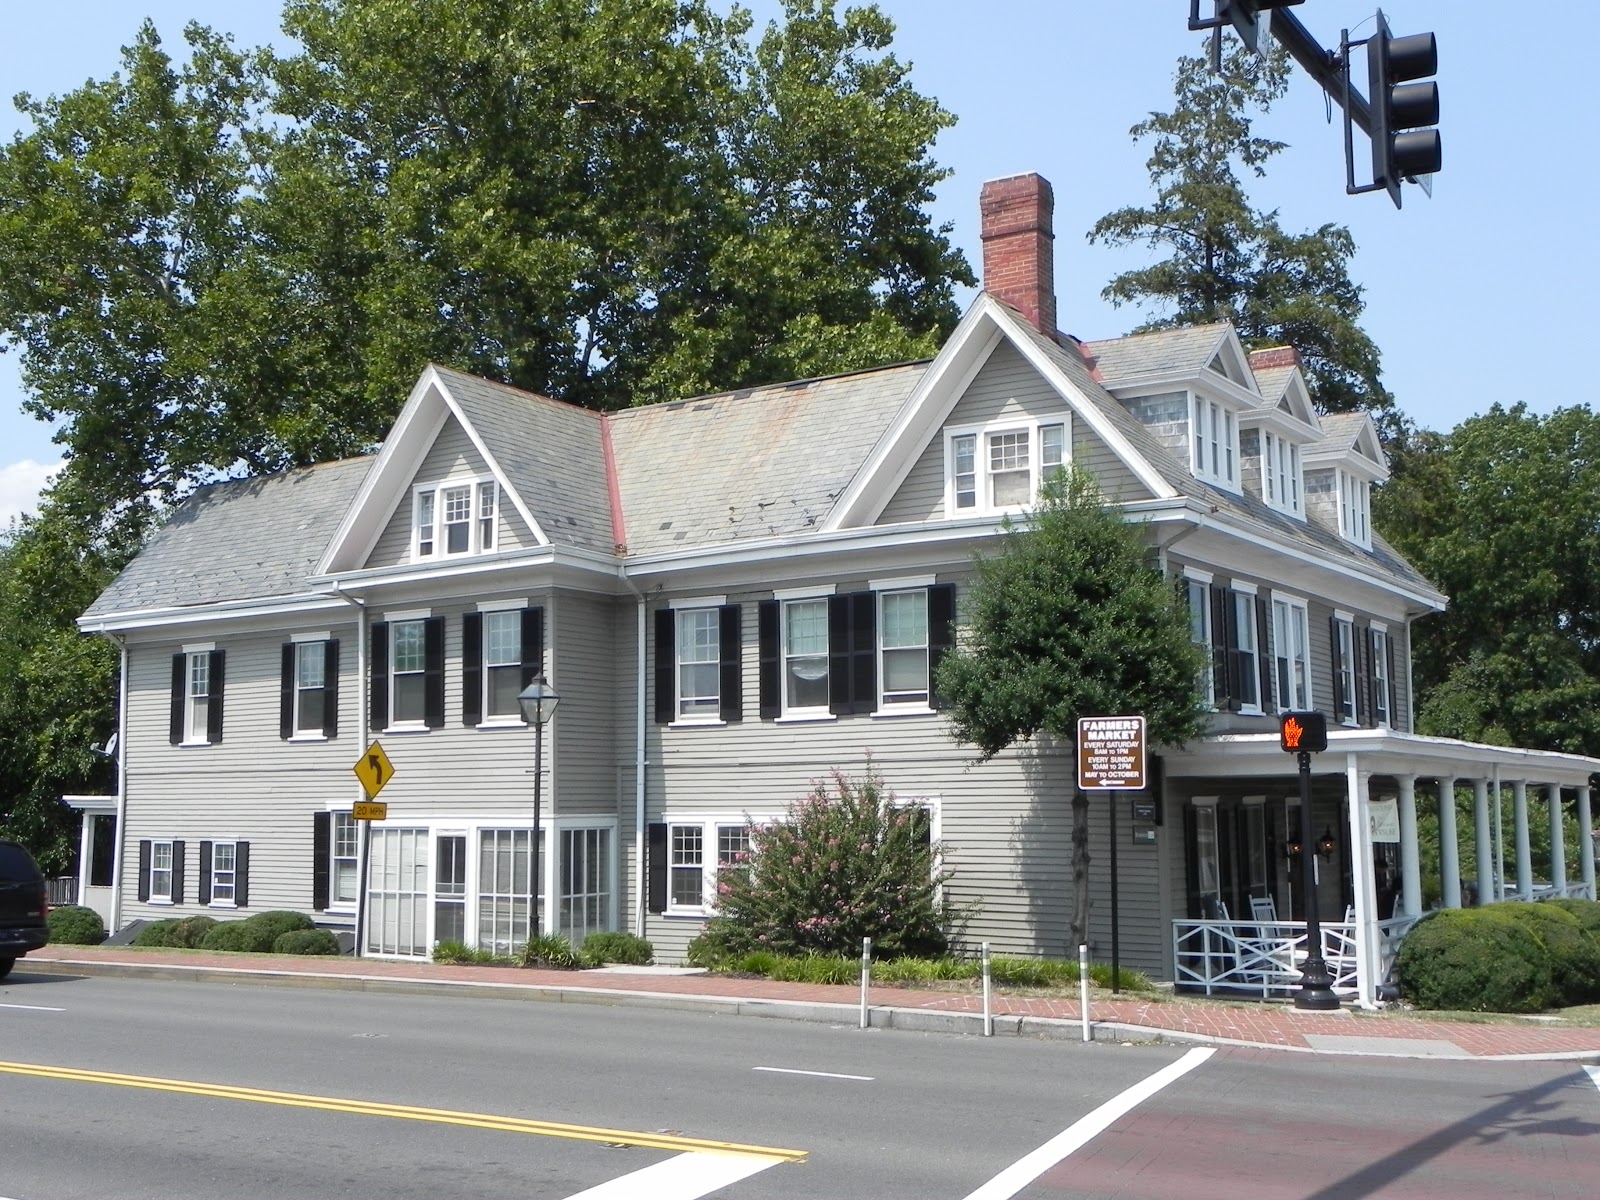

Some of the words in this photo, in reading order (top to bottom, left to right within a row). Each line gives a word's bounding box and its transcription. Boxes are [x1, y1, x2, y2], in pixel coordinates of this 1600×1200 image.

[1083, 720, 1140, 730] FARMERS
[1087, 730, 1136, 740] MARKET
[1106, 740, 1139, 748] SATURDAY
[357, 806, 367, 815] 20
[370, 806, 384, 815] MPH
